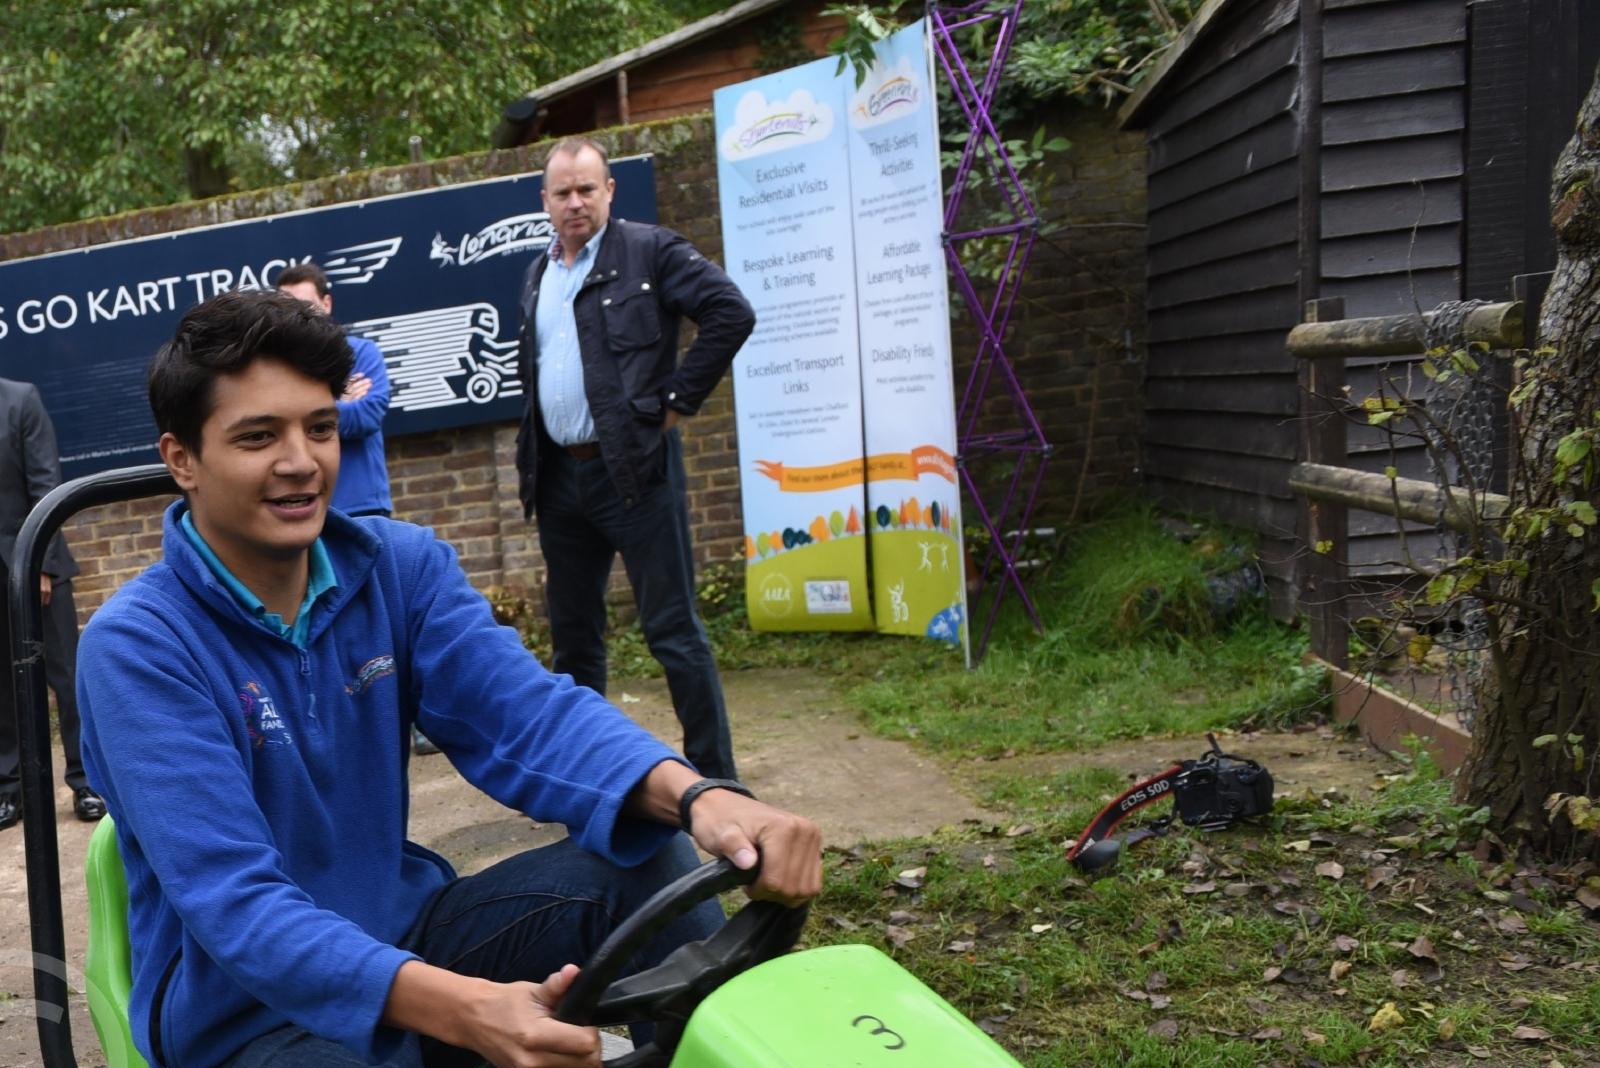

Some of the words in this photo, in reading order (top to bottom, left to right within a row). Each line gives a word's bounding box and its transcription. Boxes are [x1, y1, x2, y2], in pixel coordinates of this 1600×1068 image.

[756, 161, 806, 184] Exclusive
[739, 185, 796, 209] Residential
[799, 179, 829, 196] Visits
[743, 253, 784, 273] Bespoke
[787, 245, 835, 265] Learning
[763, 277, 772, 291] &
[774, 271, 816, 289] Training
[867, 267, 904, 285] Learning
[16, 294, 78, 334] GO
[87, 276, 183, 323] KART
[186, 254, 313, 304] TRAC
[746, 360, 793, 378] Excellent
[794, 354, 845, 373] Transport
[872, 345, 912, 363] Disability
[783, 380, 810, 395] Links
[1121, 791, 1147, 811] EOS
[1148, 779, 1169, 797] 50D
[851, 1014, 906, 1051] 3
